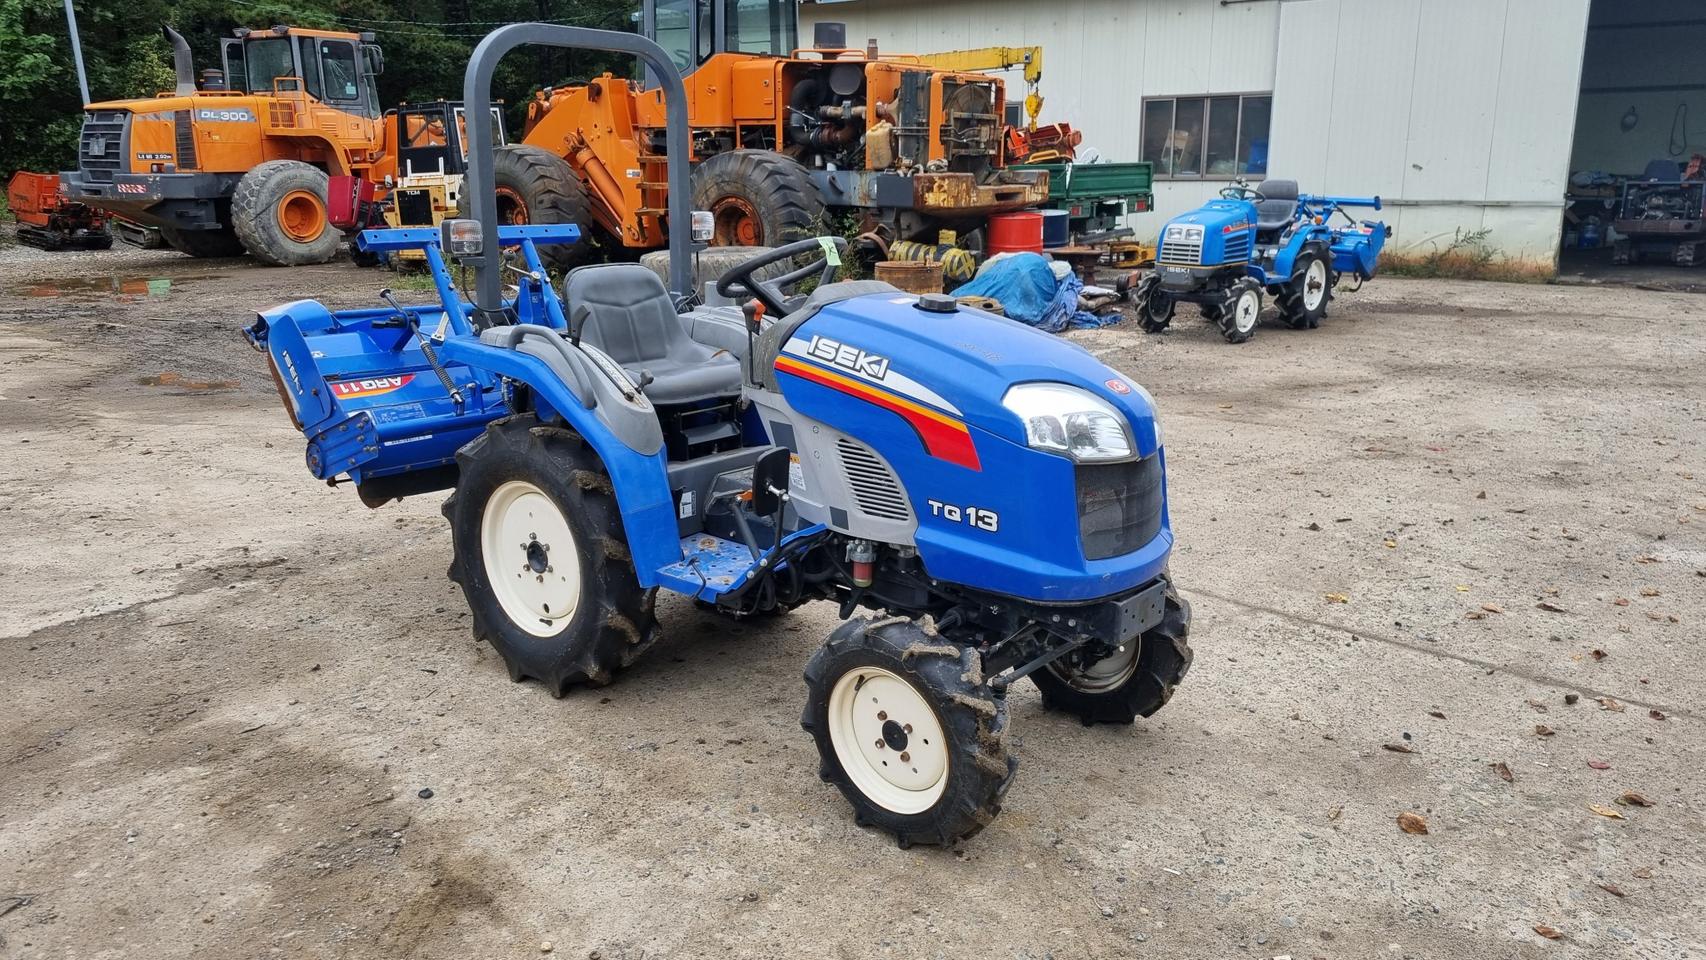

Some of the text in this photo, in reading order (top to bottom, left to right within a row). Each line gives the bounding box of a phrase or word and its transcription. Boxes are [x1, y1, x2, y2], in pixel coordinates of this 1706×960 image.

[201, 111, 248, 121] DL 300
[1166, 266, 1191, 274] ISEKI
[807, 335, 890, 381] ISEKI
[282, 349, 303, 396] ISEKI
[339, 382, 360, 394] 11
[927, 499, 998, 532] TQ 13
